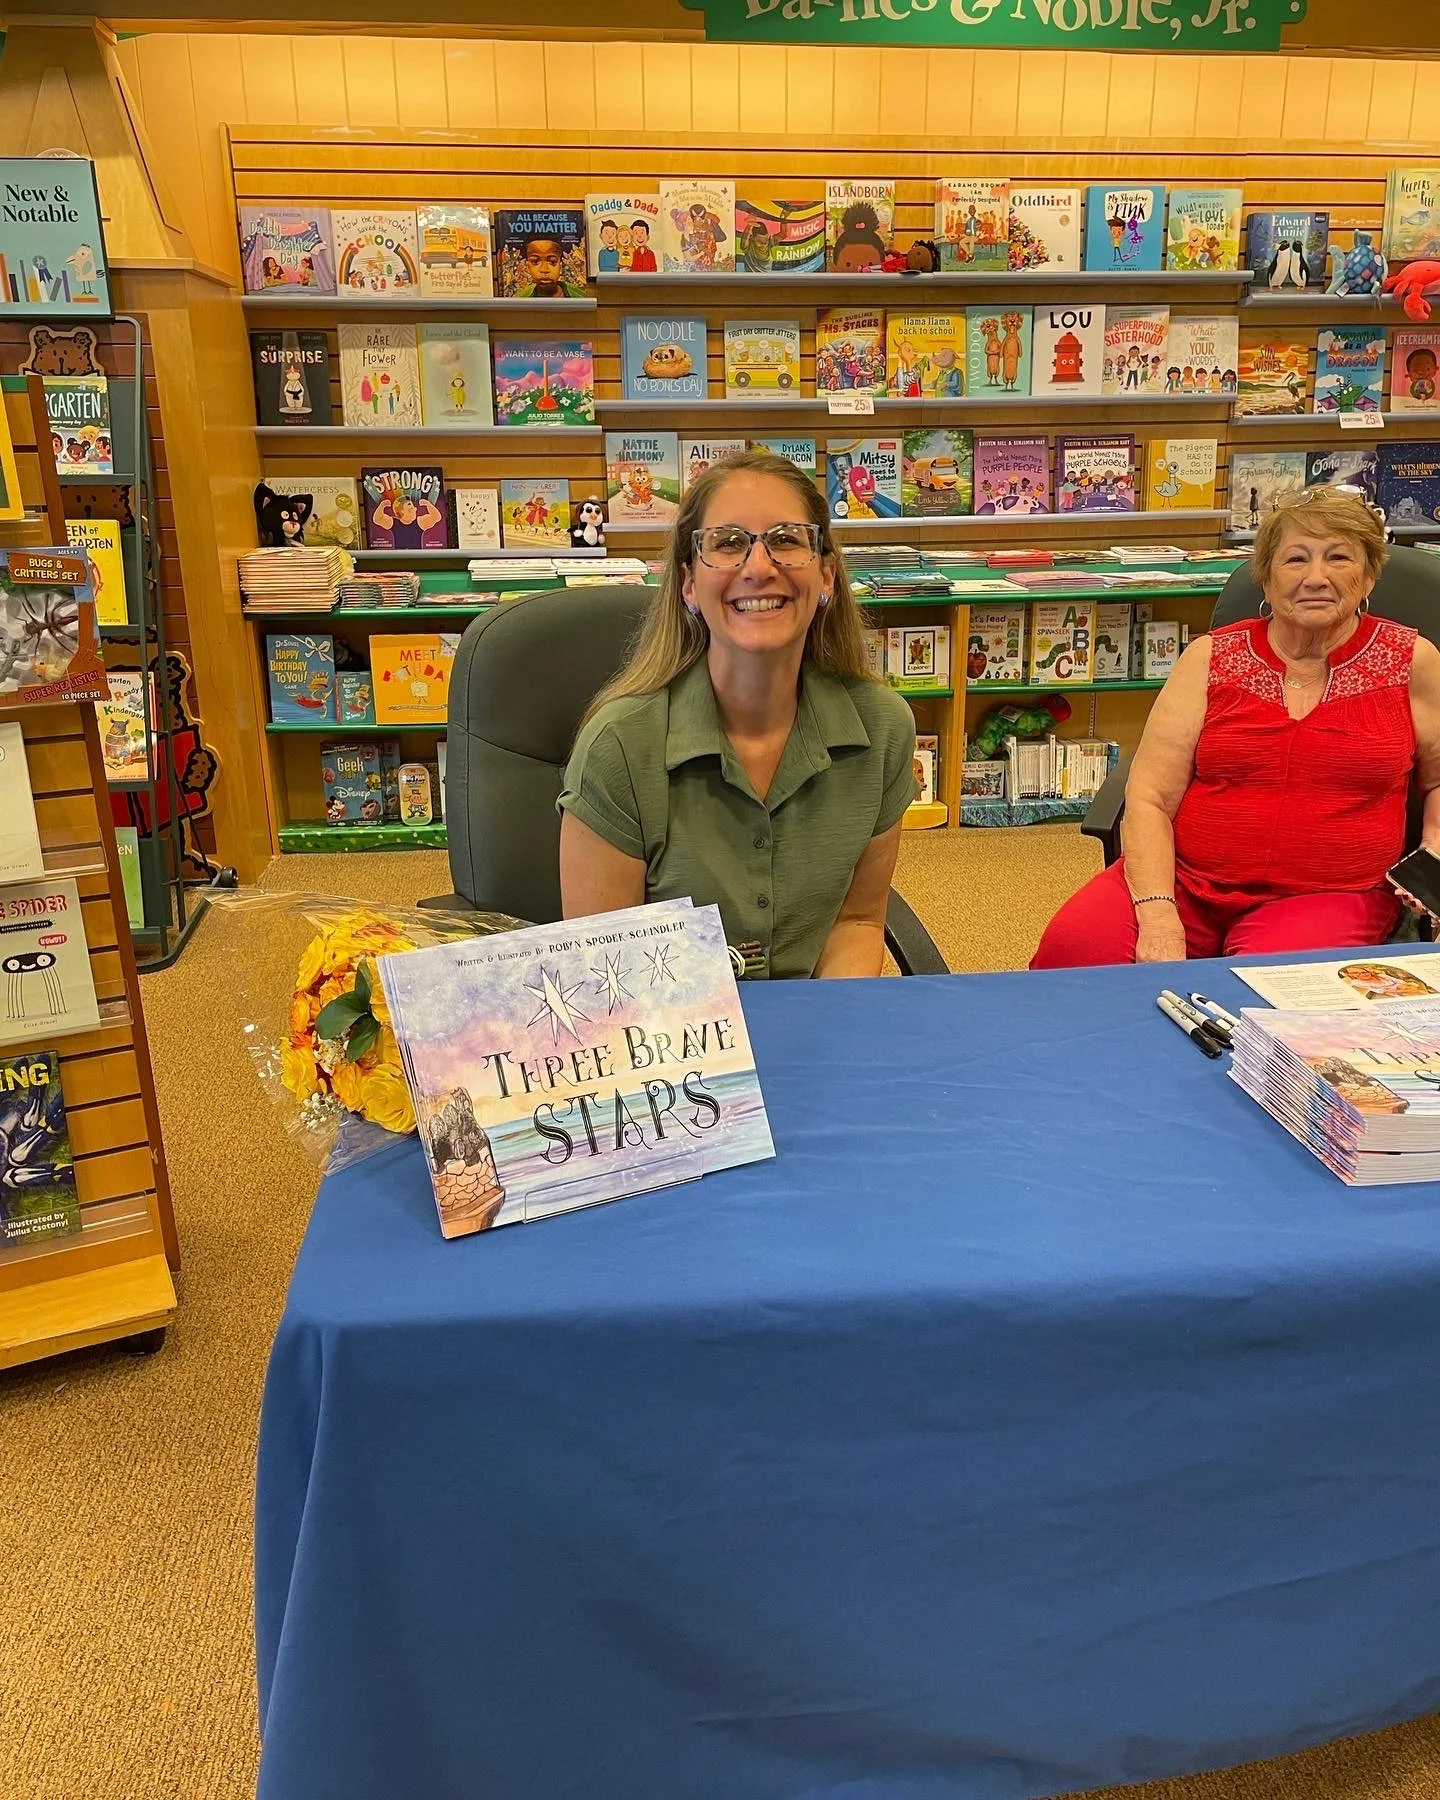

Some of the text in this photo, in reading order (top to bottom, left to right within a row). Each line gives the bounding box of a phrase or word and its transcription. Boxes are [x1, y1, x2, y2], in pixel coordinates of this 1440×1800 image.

[1401, 177, 1430, 192] KEEPERS
[4, 184, 70, 202] New &
[829, 186, 893, 198] ISLANDBORN
[1011, 195, 1072, 207] Oddbird
[1107, 194, 1119, 204] My
[1421, 191, 1435, 207] REEF
[1, 204, 79, 223] Notable
[590, 199, 659, 215] Daddy & Dada
[1114, 202, 1147, 220] PINK
[517, 213, 568, 222] ALL BECAUSE
[1200, 209, 1224, 223] LOVE
[1272, 215, 1311, 226] Edward
[341, 219, 358, 232] How
[508, 222, 577, 234] YOU MATTER
[790, 220, 820, 237] MUSIC
[1275, 226, 1305, 237] Annie
[348, 234, 402, 255] SCHOOL
[281, 252, 299, 270] Day
[845, 312, 873, 321] SUBLIME
[903, 317, 950, 326] llama llama
[1050, 311, 1091, 328] LOU
[638, 321, 696, 341] NOODLE
[843, 319, 879, 332] STACKS
[898, 326, 955, 335] back to school
[1114, 320, 1165, 334] SUPERPOWER
[1188, 324, 1217, 336] What
[728, 327, 796, 340] FIRST DAY CRITTER JITTERS
[1104, 330, 1163, 346] SISTERHOOD
[1397, 335, 1408, 344] ICE
[367, 335, 390, 346] RARE
[505, 350, 529, 358] WANT
[531, 350, 542, 358] TO
[544, 350, 554, 358] BE
[565, 350, 585, 358] VASE
[1190, 342, 1215, 355] YOUR
[1260, 347, 1275, 360] SUN
[260, 350, 324, 364] SURPRISE
[1189, 355, 1216, 366] WORDS?
[1327, 354, 1378, 368] DRAGON
[1253, 360, 1281, 372] WISHES
[969, 357, 981, 392] TWO
[633, 379, 648, 392] NO
[651, 379, 681, 392] BONES
[623, 439, 659, 450] HATTIE
[782, 443, 810, 452] DYLAN'S
[1185, 444, 1213, 452] Pigeon
[619, 451, 665, 462] HARMONY
[690, 445, 710, 459] Ali
[860, 452, 895, 468] Mitsy
[1066, 459, 1128, 469] PURPLE SCHOOLS
[983, 463, 1043, 474] PURPLE PEOPLE
[1312, 459, 1340, 476] Oona
[372, 470, 433, 494] STRONG
[89, 526, 98, 535] of
[29, 559, 53, 568] BUGS
[14, 569, 78, 580] CRITTERS SET
[1062, 606, 1080, 628] A
[1072, 629, 1089, 650] B
[275, 649, 299, 660] HAPPY
[400, 650, 437, 661] MEET
[270, 660, 308, 671] BIRTHDAY
[1055, 655, 1072, 678] C
[24, 671, 99, 702] SUPER REALISTIC!
[90, 690, 101, 698] SET
[337, 757, 364, 772] Geek
[334, 786, 371, 801] Disney
[549, 940, 581, 953] ROBYN
[1348, 1047, 1440, 1065] THR
[532, 1070, 722, 1165] STARS
[6, 1219, 68, 1238] Julius Csotonyi
[8, 1215, 52, 1230] Illustrated
